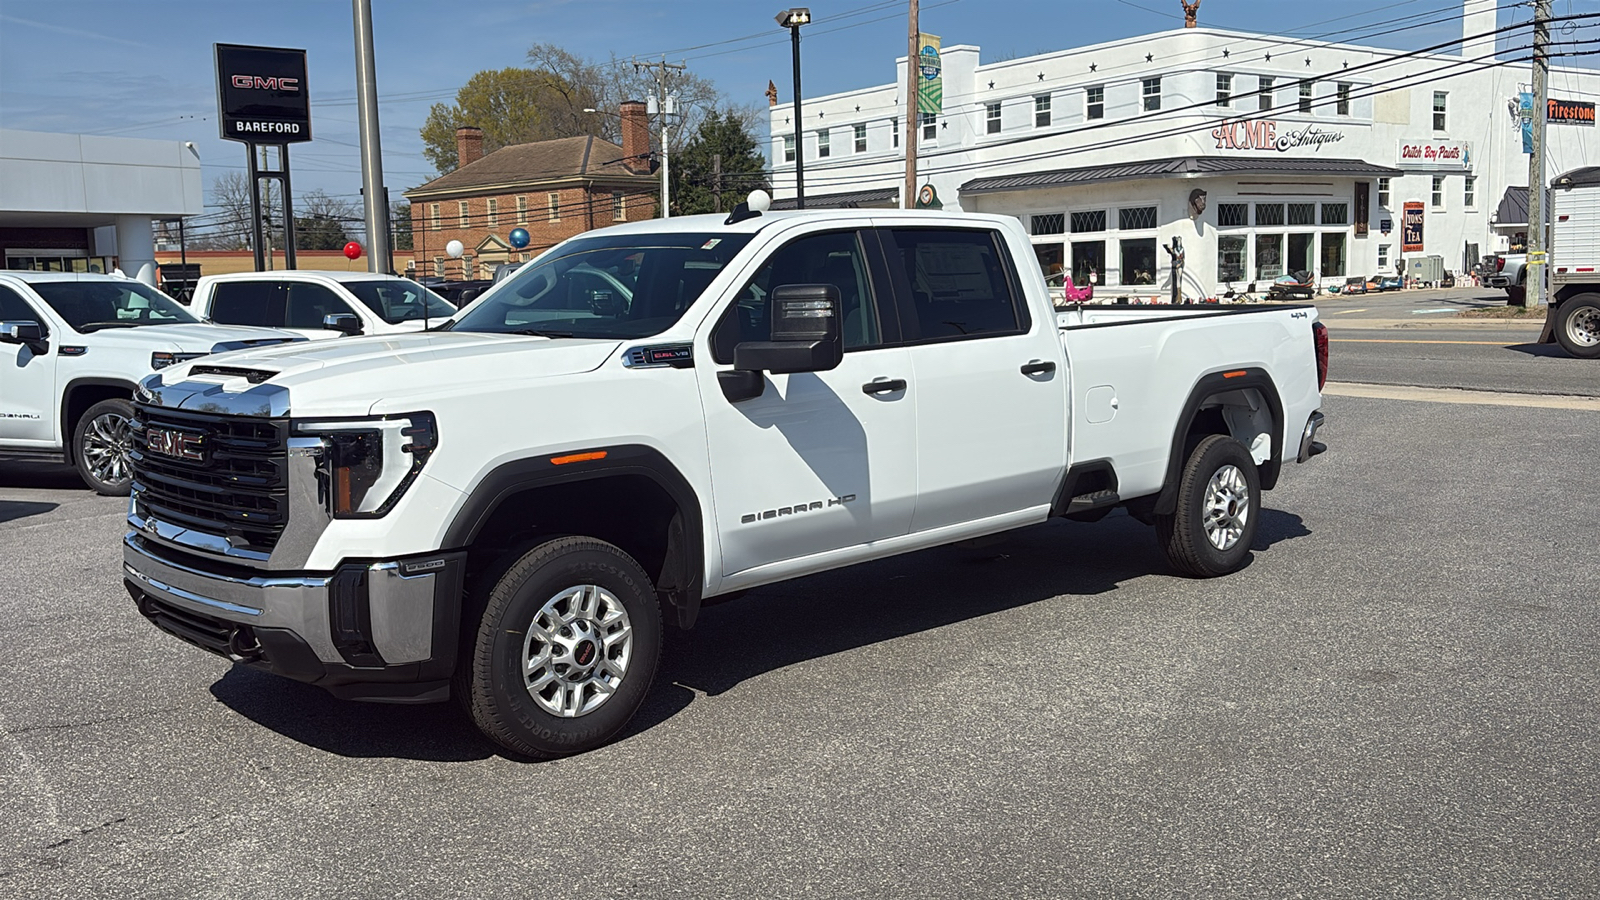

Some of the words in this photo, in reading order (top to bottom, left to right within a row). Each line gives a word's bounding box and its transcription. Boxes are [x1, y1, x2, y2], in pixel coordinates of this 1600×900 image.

[231, 75, 299, 91] GMC
[1546, 99, 1595, 120] Firestone
[236, 121, 300, 134] BAREFORD
[1212, 119, 1277, 151] ACME
[1402, 144, 1422, 159] Dutch
[1424, 145, 1438, 161] Boy
[1438, 145, 1460, 159] Paints
[1407, 229, 1421, 242] TEA
[146, 428, 203, 461] GMC
[741, 501, 823, 524] SIERRA
[827, 494, 857, 508] HD
